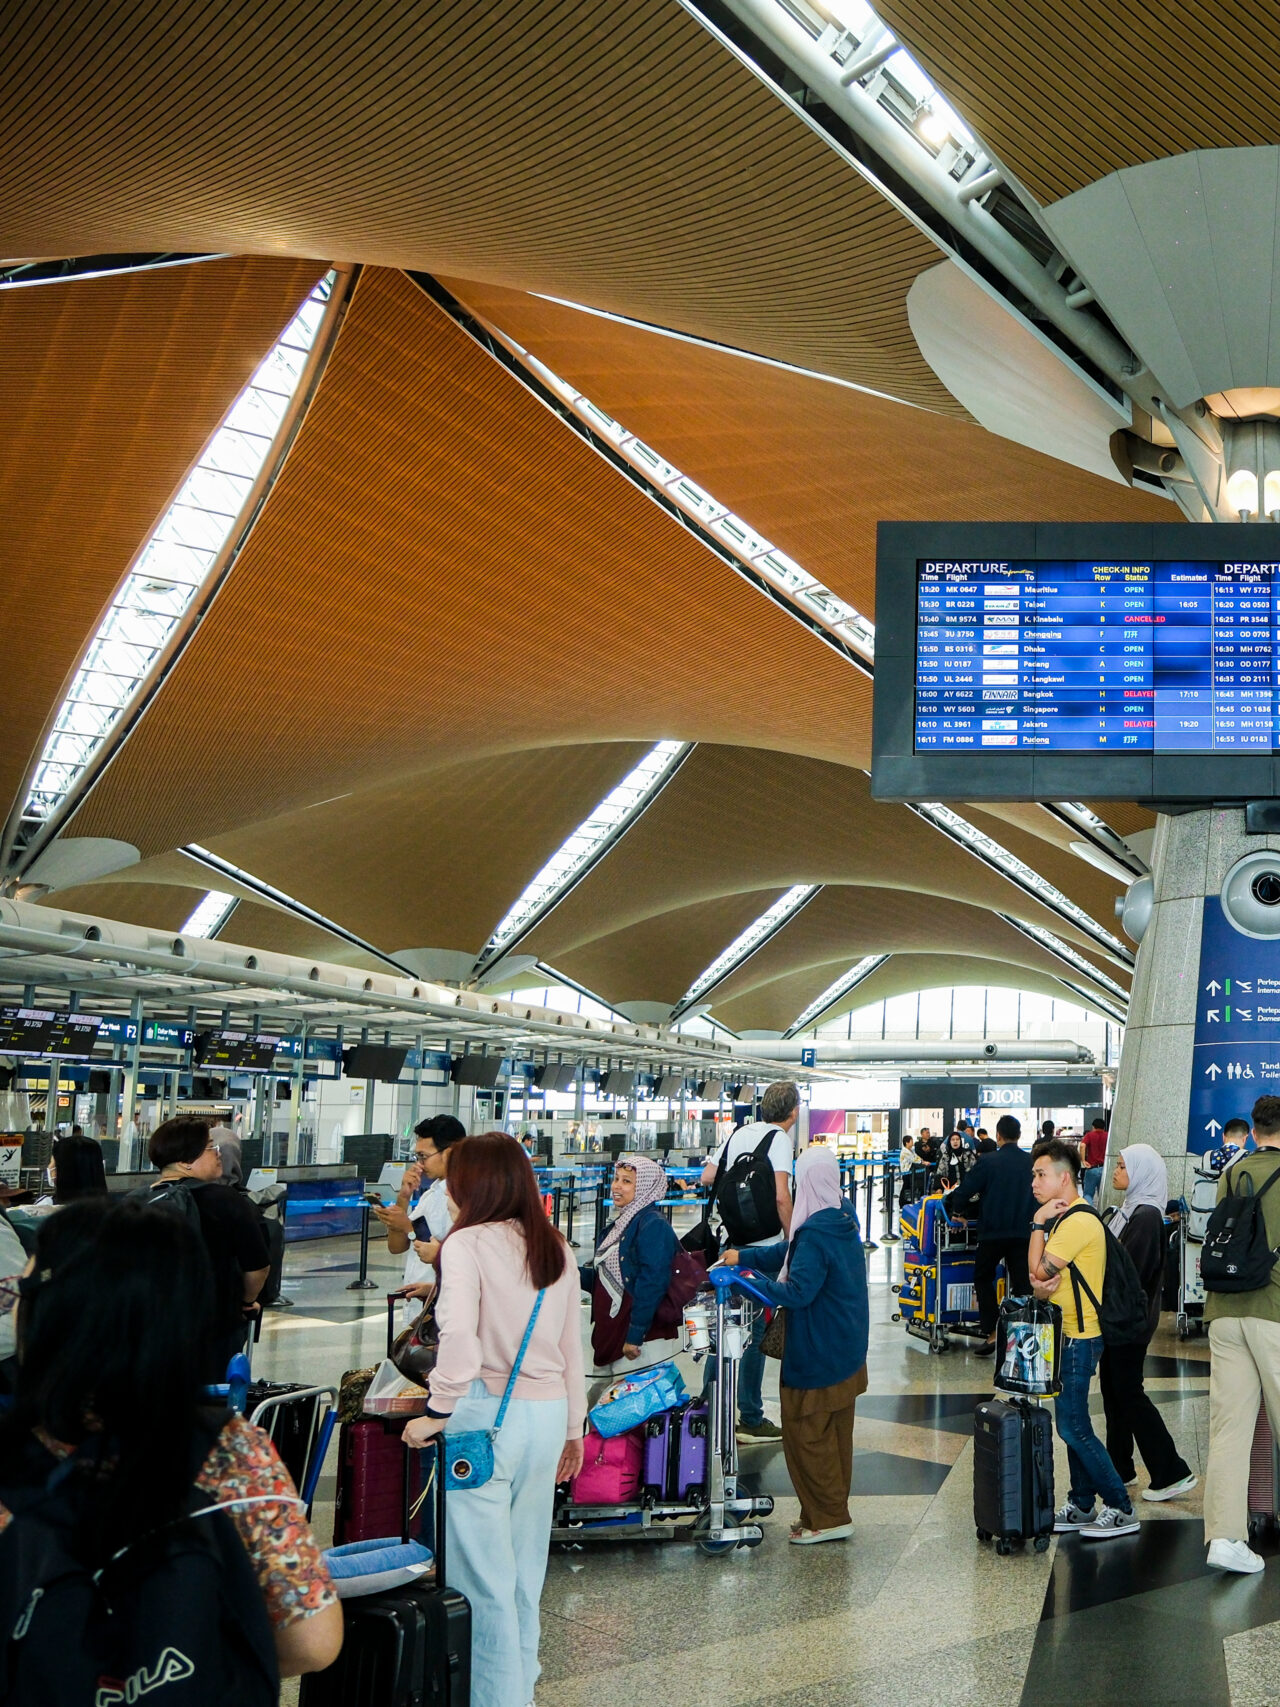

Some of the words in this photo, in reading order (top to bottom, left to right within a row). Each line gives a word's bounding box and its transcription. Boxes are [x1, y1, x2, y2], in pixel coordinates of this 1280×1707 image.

[926, 564, 1008, 573] DEPARTURE
[946, 574, 968, 582] Flight
[984, 691, 1017, 699] FINNAIR
[1023, 706, 1058, 714] Singapore
[127, 1026, 136, 1038] F2
[185, 1031, 193, 1044] F3
[804, 1051, 811, 1062] F
[983, 1090, 1025, 1104] DIOR
[96, 1647, 194, 1707] FILA
